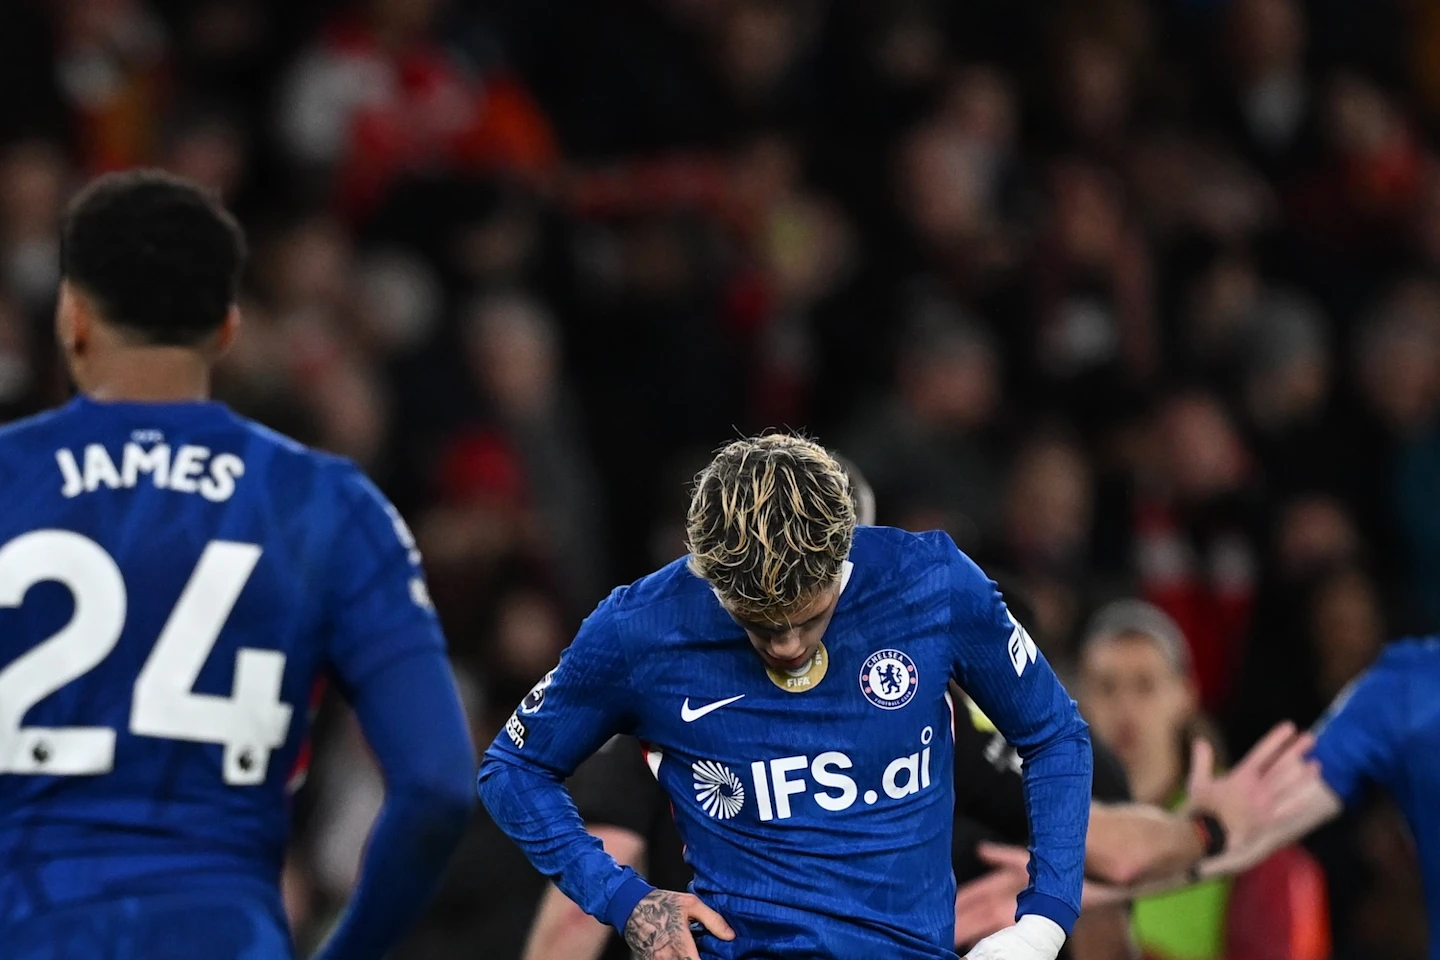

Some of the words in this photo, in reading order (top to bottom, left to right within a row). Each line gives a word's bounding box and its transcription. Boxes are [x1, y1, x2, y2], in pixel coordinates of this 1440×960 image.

[55, 442, 245, 501] JAMES
[866, 651, 904, 668] CHELSEA
[786, 676, 811, 688] FIFA
[751, 726, 933, 821] IFS.ai
